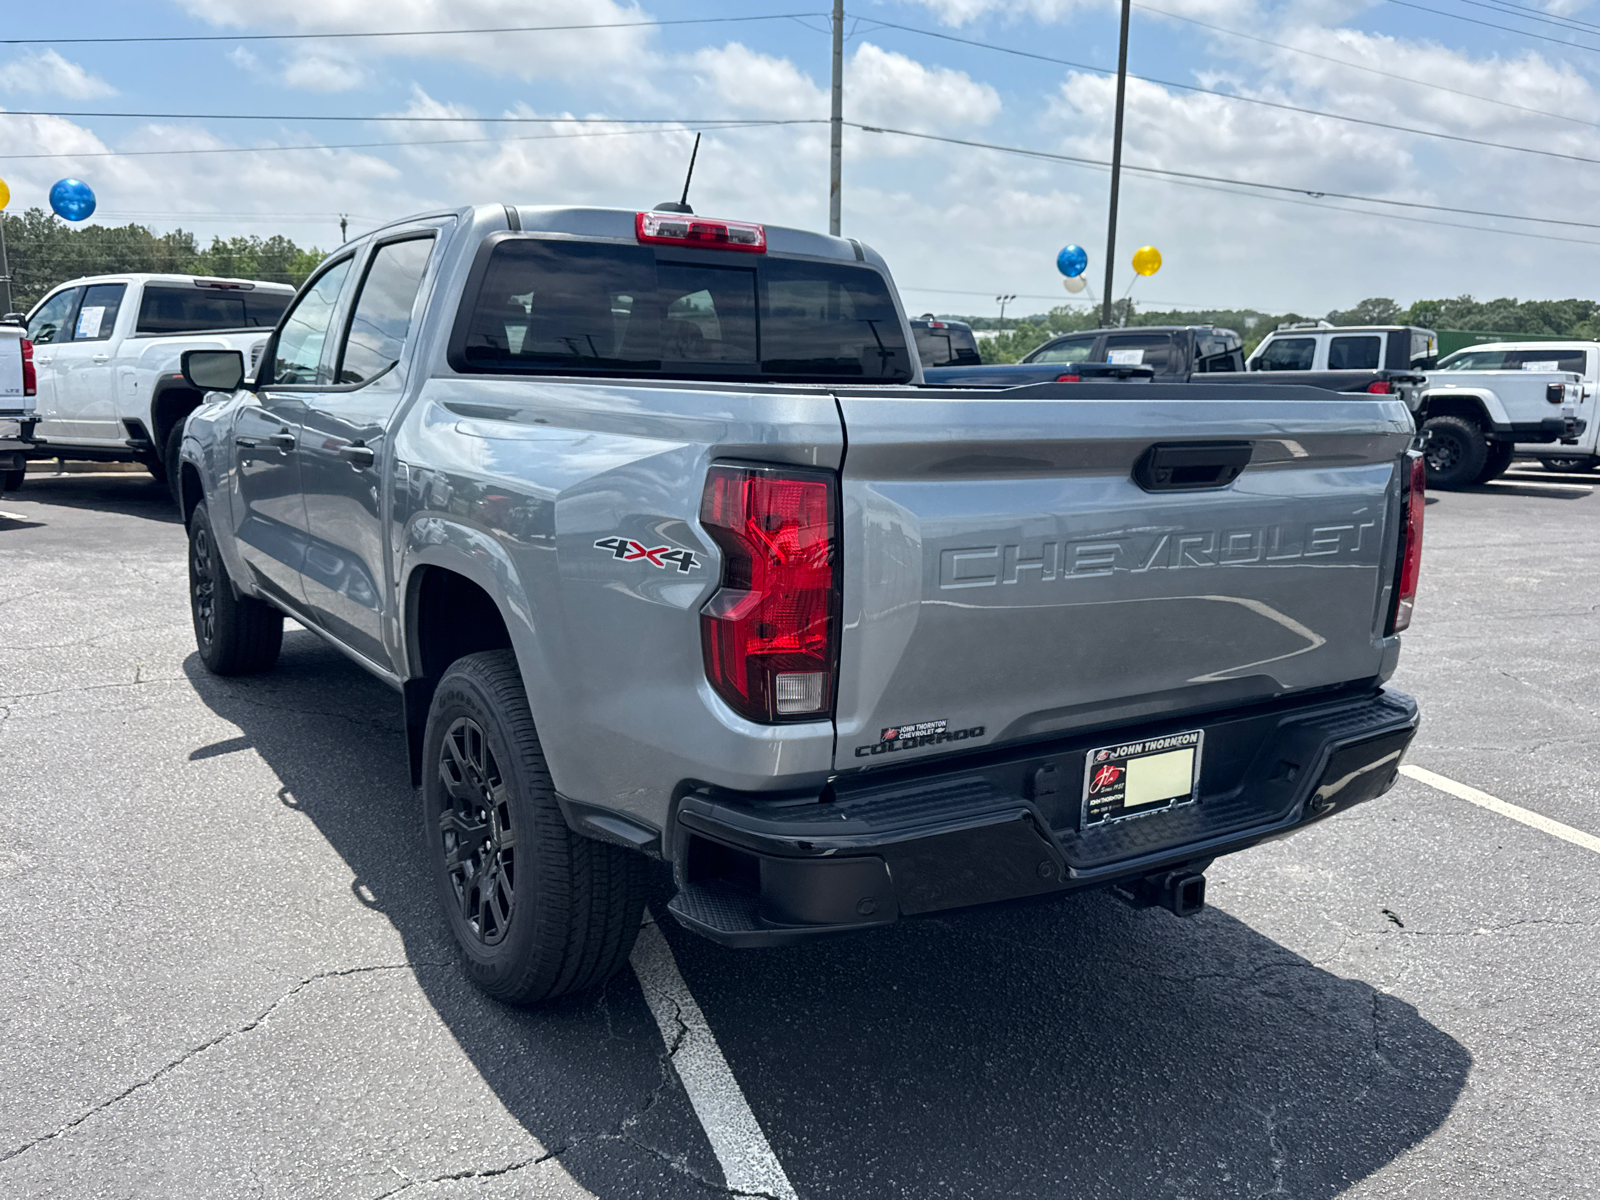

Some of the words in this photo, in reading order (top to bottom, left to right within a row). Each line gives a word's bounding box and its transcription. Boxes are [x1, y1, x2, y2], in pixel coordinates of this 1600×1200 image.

[939, 519, 1375, 589] CHEVROLET
[899, 726, 915, 734] JOHN
[916, 720, 947, 731] THORNTON
[899, 728, 935, 739] CHEVROLET
[855, 726, 986, 757] COLORADO
[1115, 745, 1142, 757] JOHN
[1145, 733, 1198, 751] THORNTON
